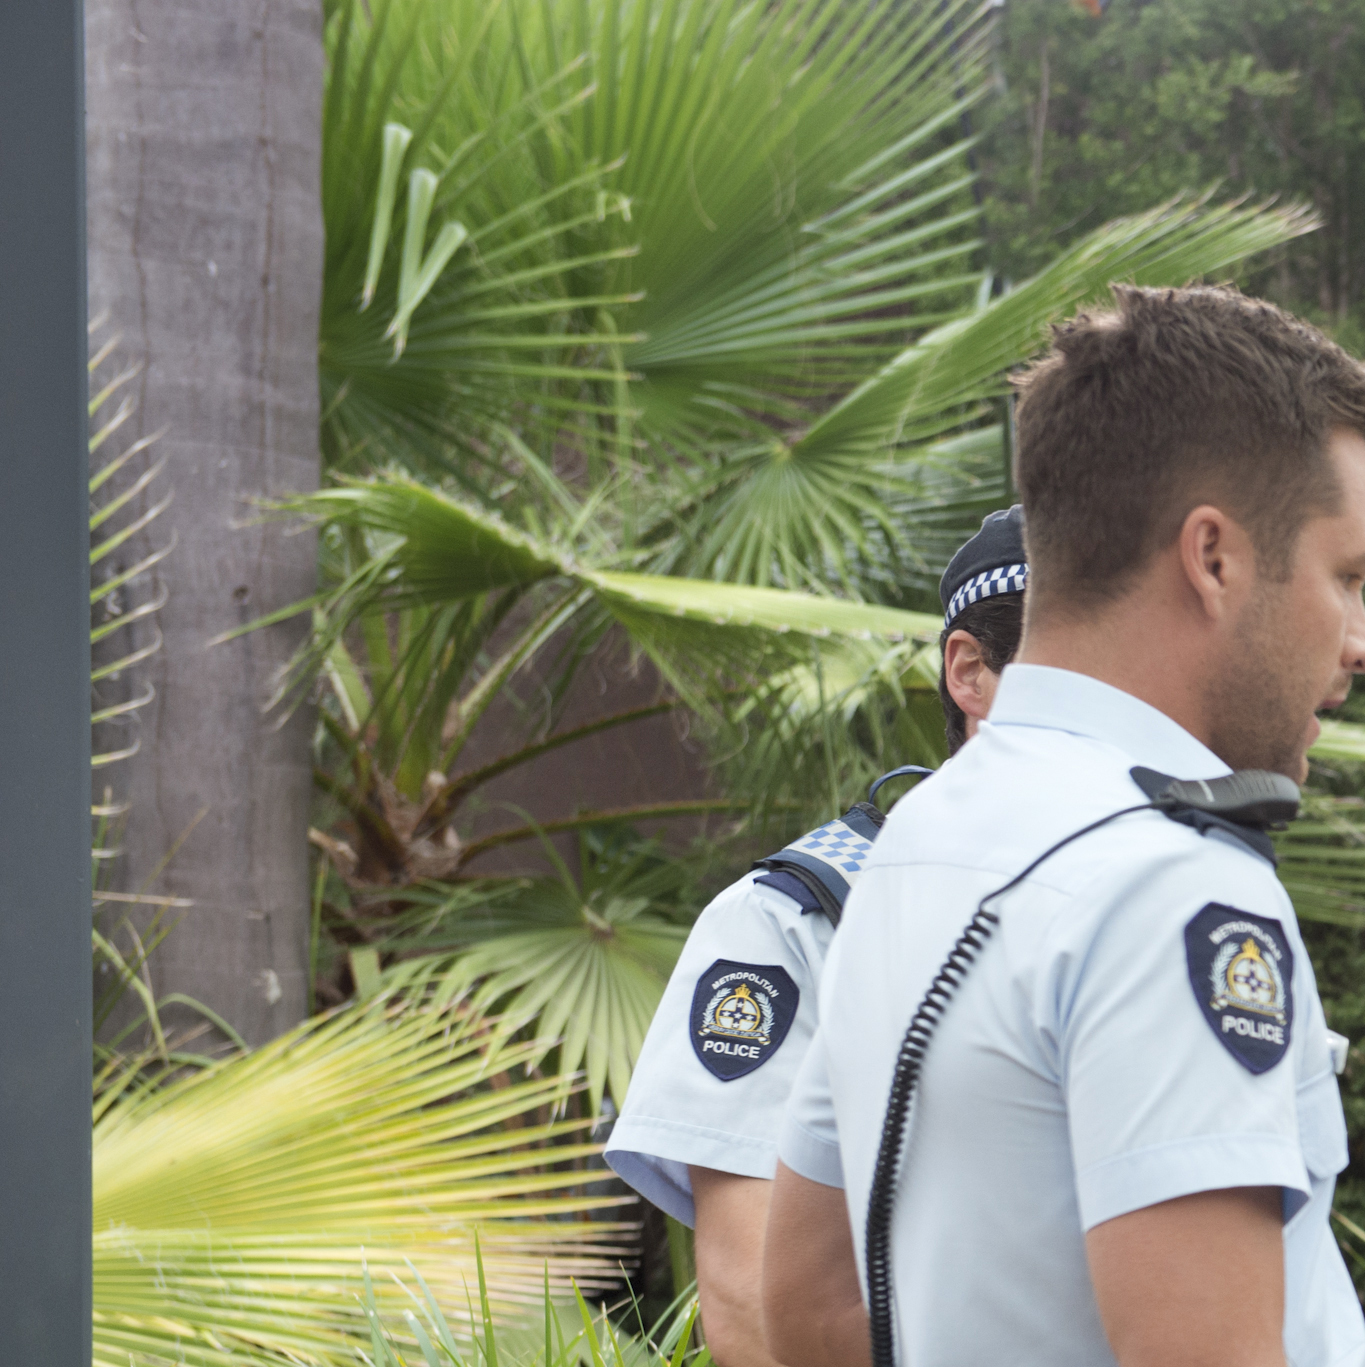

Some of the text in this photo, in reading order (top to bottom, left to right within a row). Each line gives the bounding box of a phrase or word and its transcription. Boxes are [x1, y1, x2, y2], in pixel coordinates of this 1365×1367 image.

[1208, 920, 1283, 962] METROPOLITAN
[711, 971, 780, 998] METROPOLITAN
[1221, 1014, 1285, 1045] POLICE
[702, 1040, 761, 1059] POLICE
